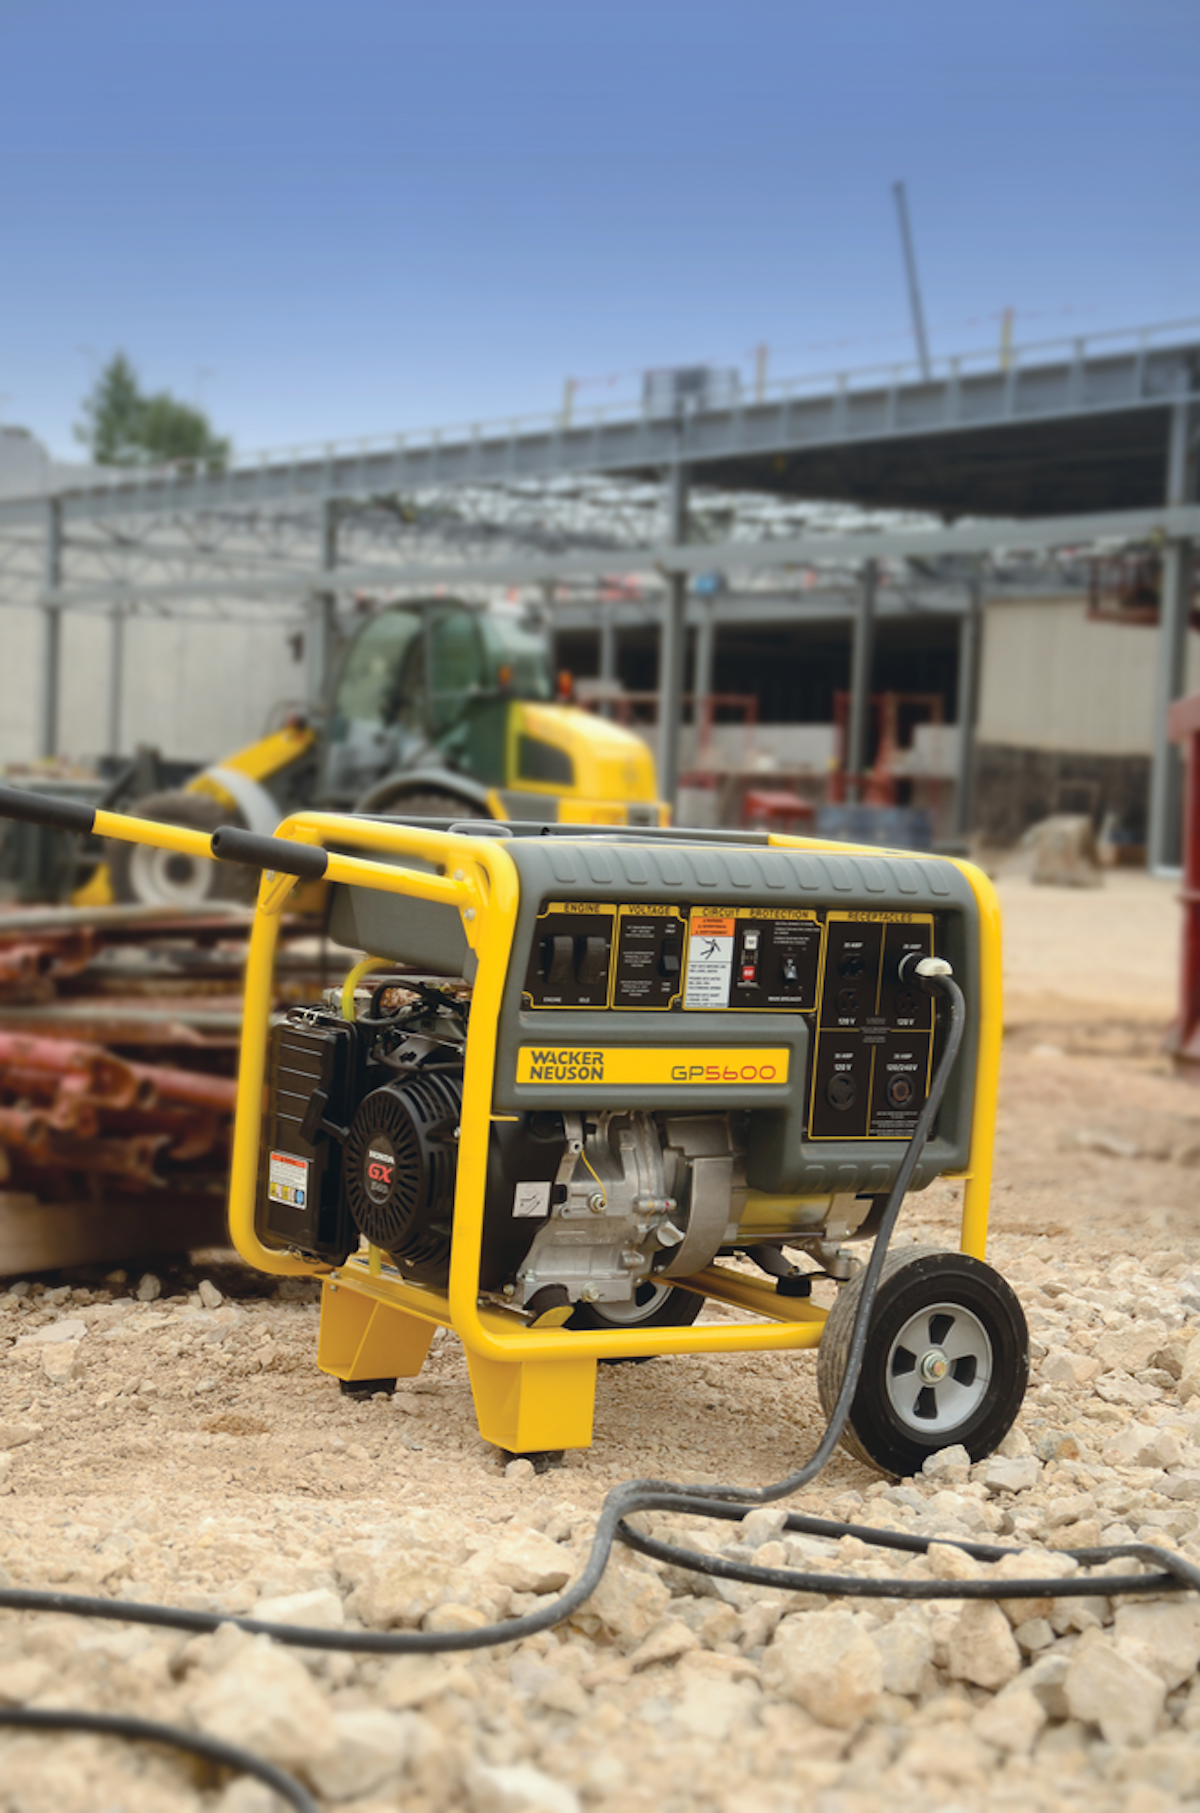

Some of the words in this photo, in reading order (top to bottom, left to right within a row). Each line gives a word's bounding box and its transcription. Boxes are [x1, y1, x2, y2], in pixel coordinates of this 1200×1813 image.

[564, 903, 600, 913] ENGINE
[628, 905, 670, 915] VOLTAGE
[702, 907, 740, 917] CIRCUIT
[750, 909, 809, 919] PROTECTION
[848, 911, 913, 923] RECEPTACLES
[531, 1051, 604, 1065] WACKER
[530, 1066, 604, 1080] NEUSON
[671, 1065, 776, 1081] GP5600
[368, 1163, 393, 1183] GX
